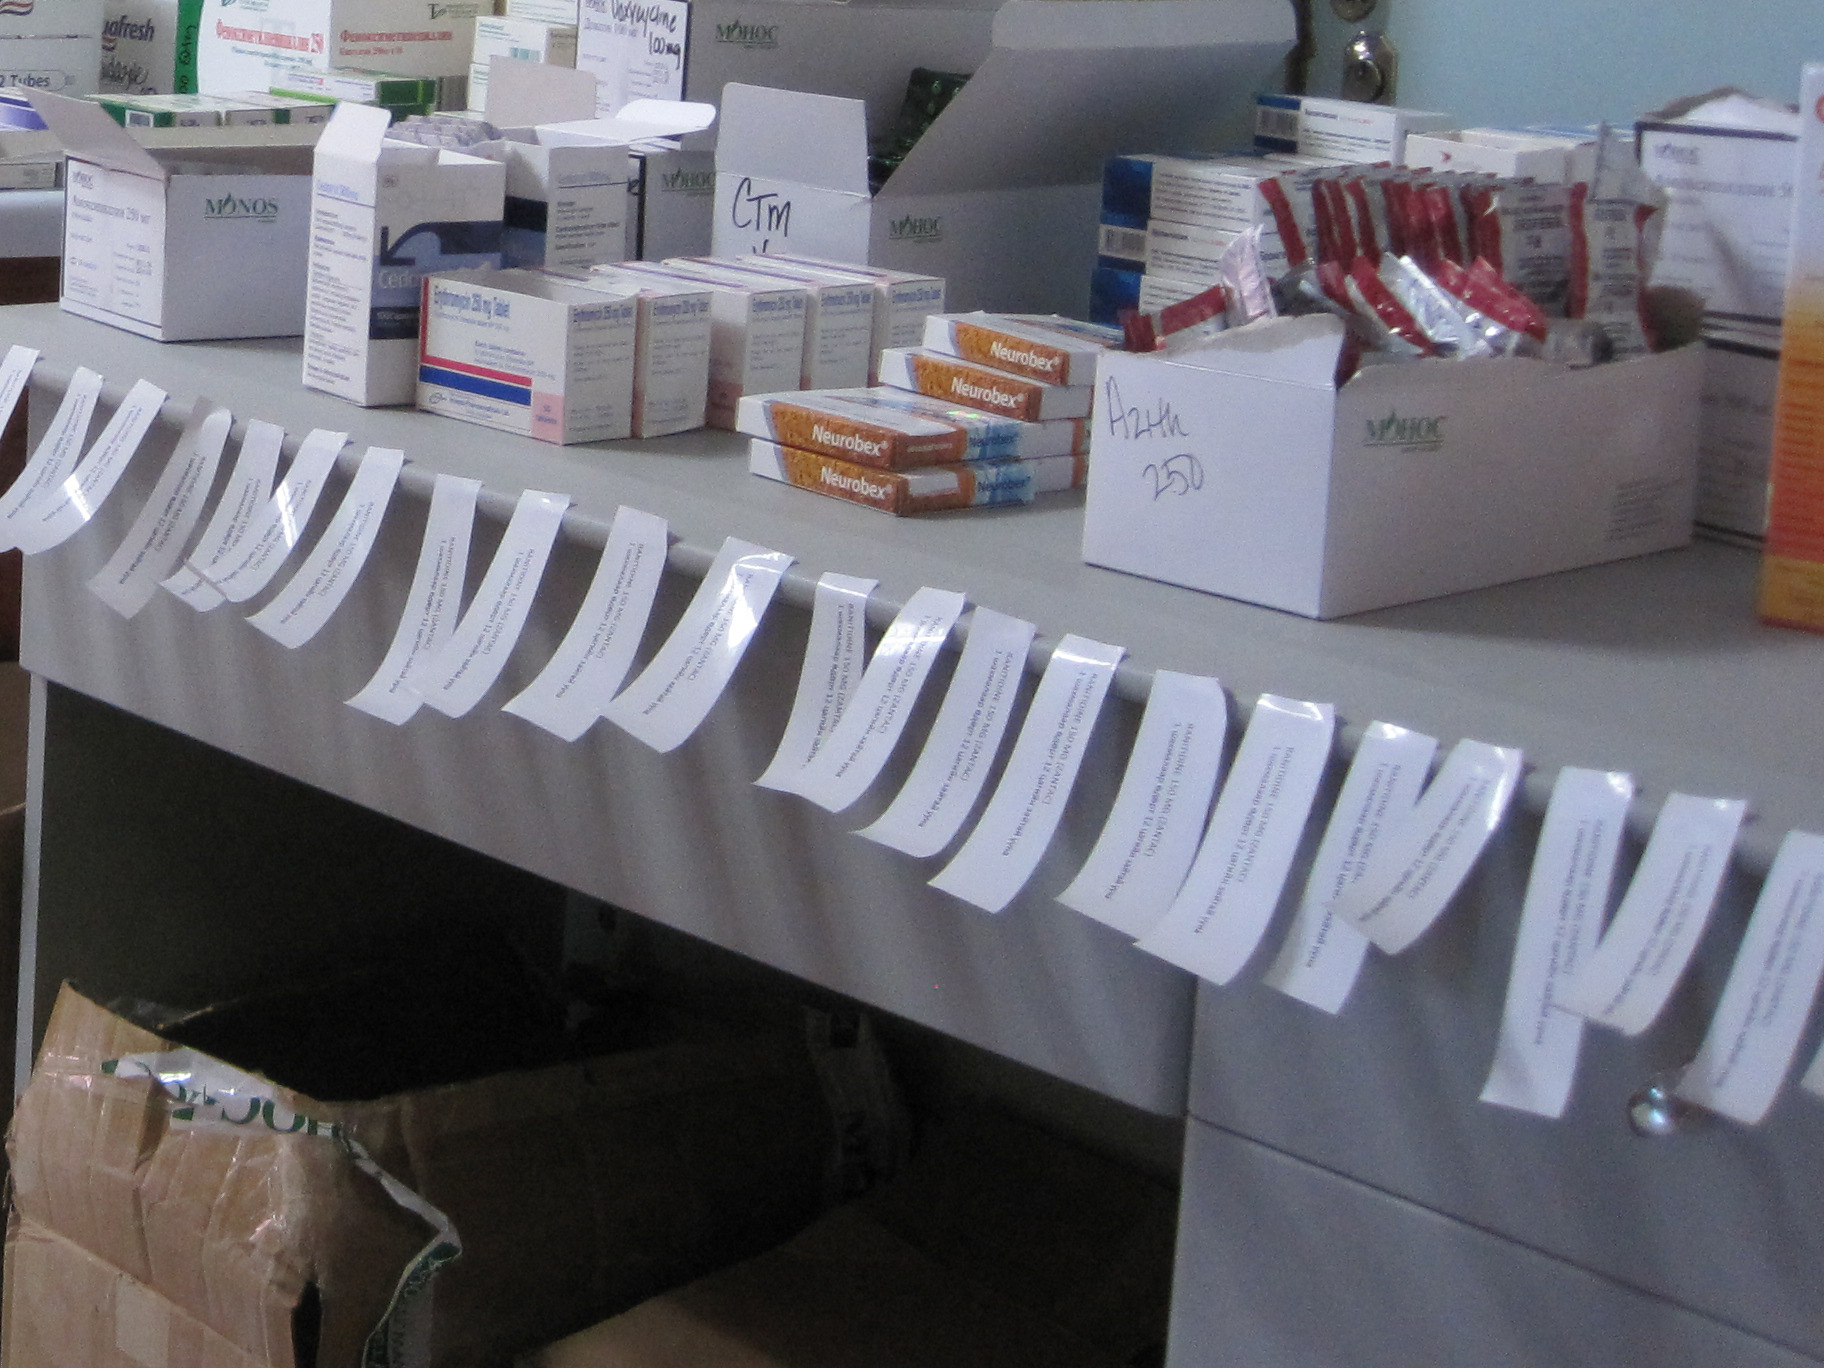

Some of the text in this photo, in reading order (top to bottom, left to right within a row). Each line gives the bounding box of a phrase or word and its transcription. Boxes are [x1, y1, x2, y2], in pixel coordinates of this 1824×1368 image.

[103, 15, 155, 43] uafresh
[204, 194, 278, 216] MONOS
[951, 377, 1019, 410] Neurobex
[812, 425, 883, 458] Neurobex
[821, 466, 888, 501] Neurobex
[1142, 452, 1205, 502] 250
[913, 615, 943, 660] RANIDINE
[827, 692, 845, 733] (ZANTA
[803, 736, 822, 764] зайта
